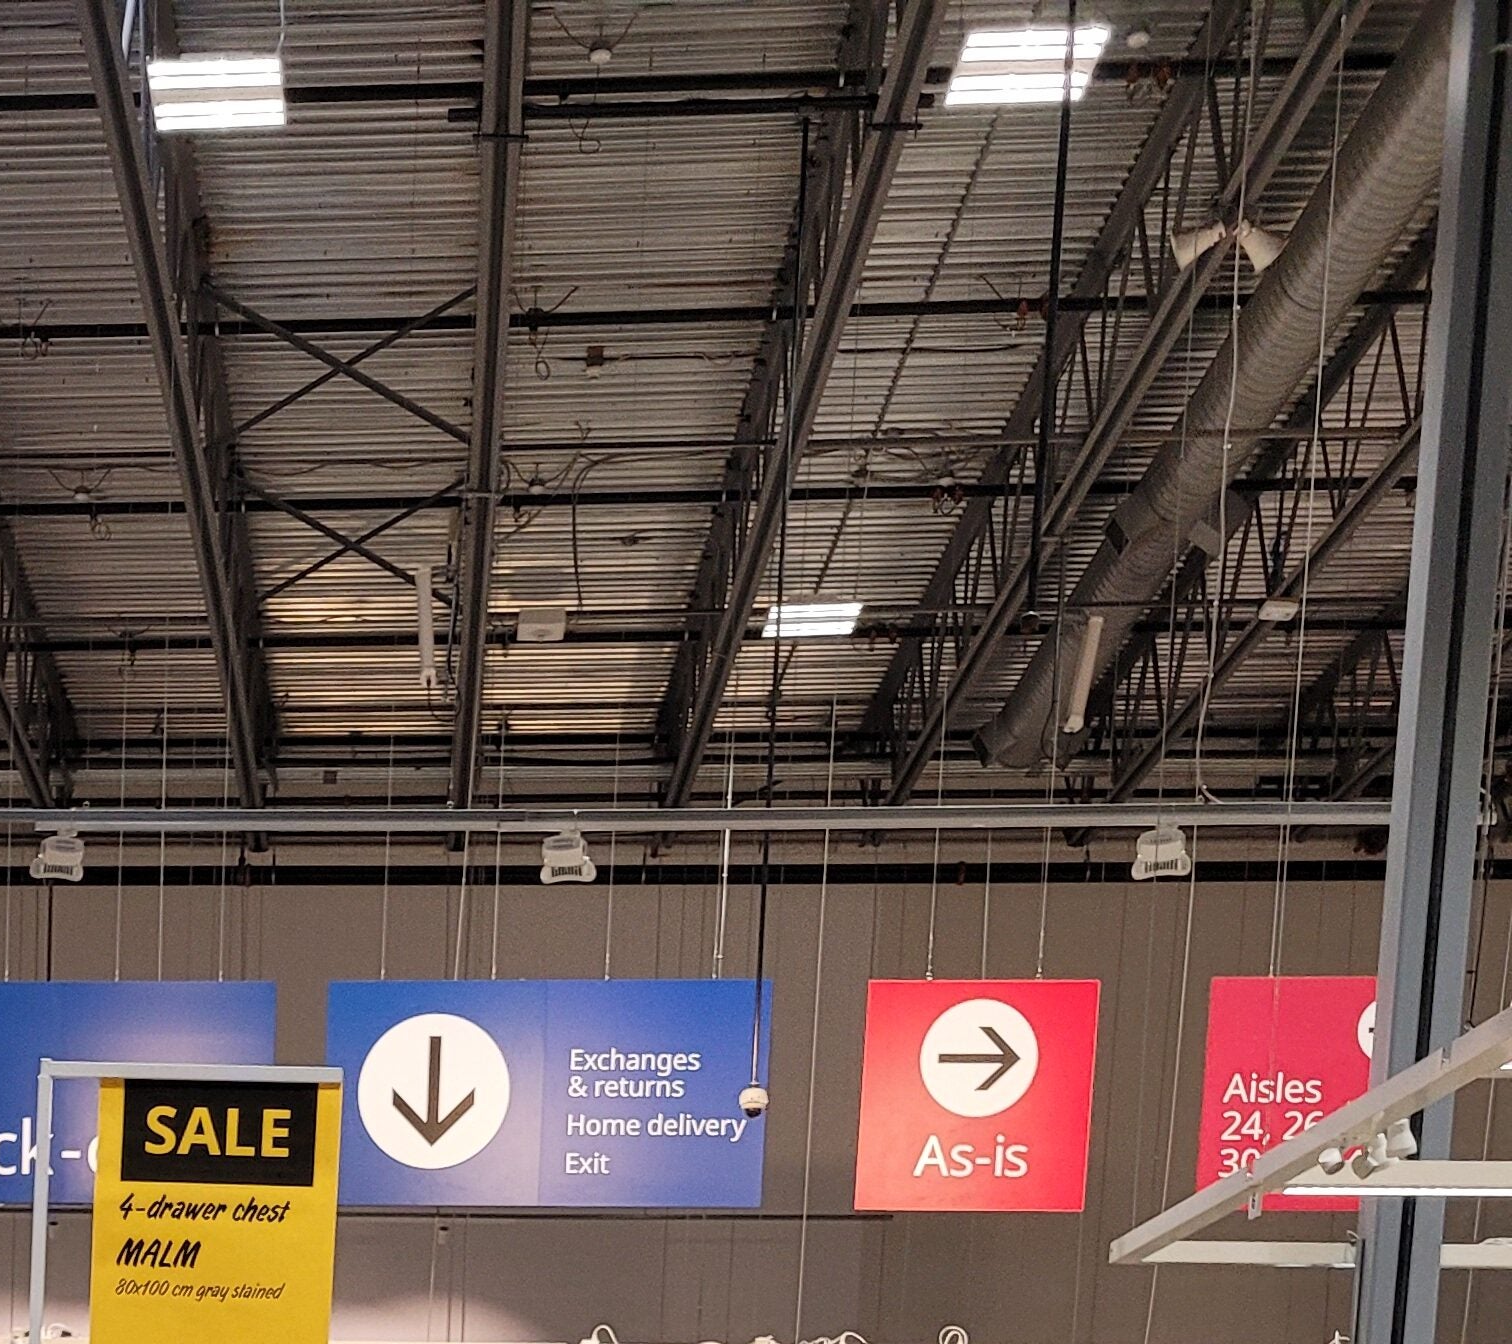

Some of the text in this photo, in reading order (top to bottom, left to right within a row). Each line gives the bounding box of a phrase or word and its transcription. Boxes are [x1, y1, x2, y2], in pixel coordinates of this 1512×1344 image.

[569, 1047, 702, 1077] Exchanges
[567, 1075, 685, 1098] & returns
[1222, 1071, 1322, 1104] Aisles
[143, 1104, 293, 1160] SALE
[566, 1112, 747, 1142] Home delivery
[1220, 1110, 1271, 1146] 24,
[564, 1152, 610, 1175] Exit
[912, 1134, 1030, 1178] As-is
[119, 1192, 291, 1223] 4-drawer chest
[115, 1237, 202, 1269] MALM
[115, 1277, 286, 1303] 80x100 cm gray stained
